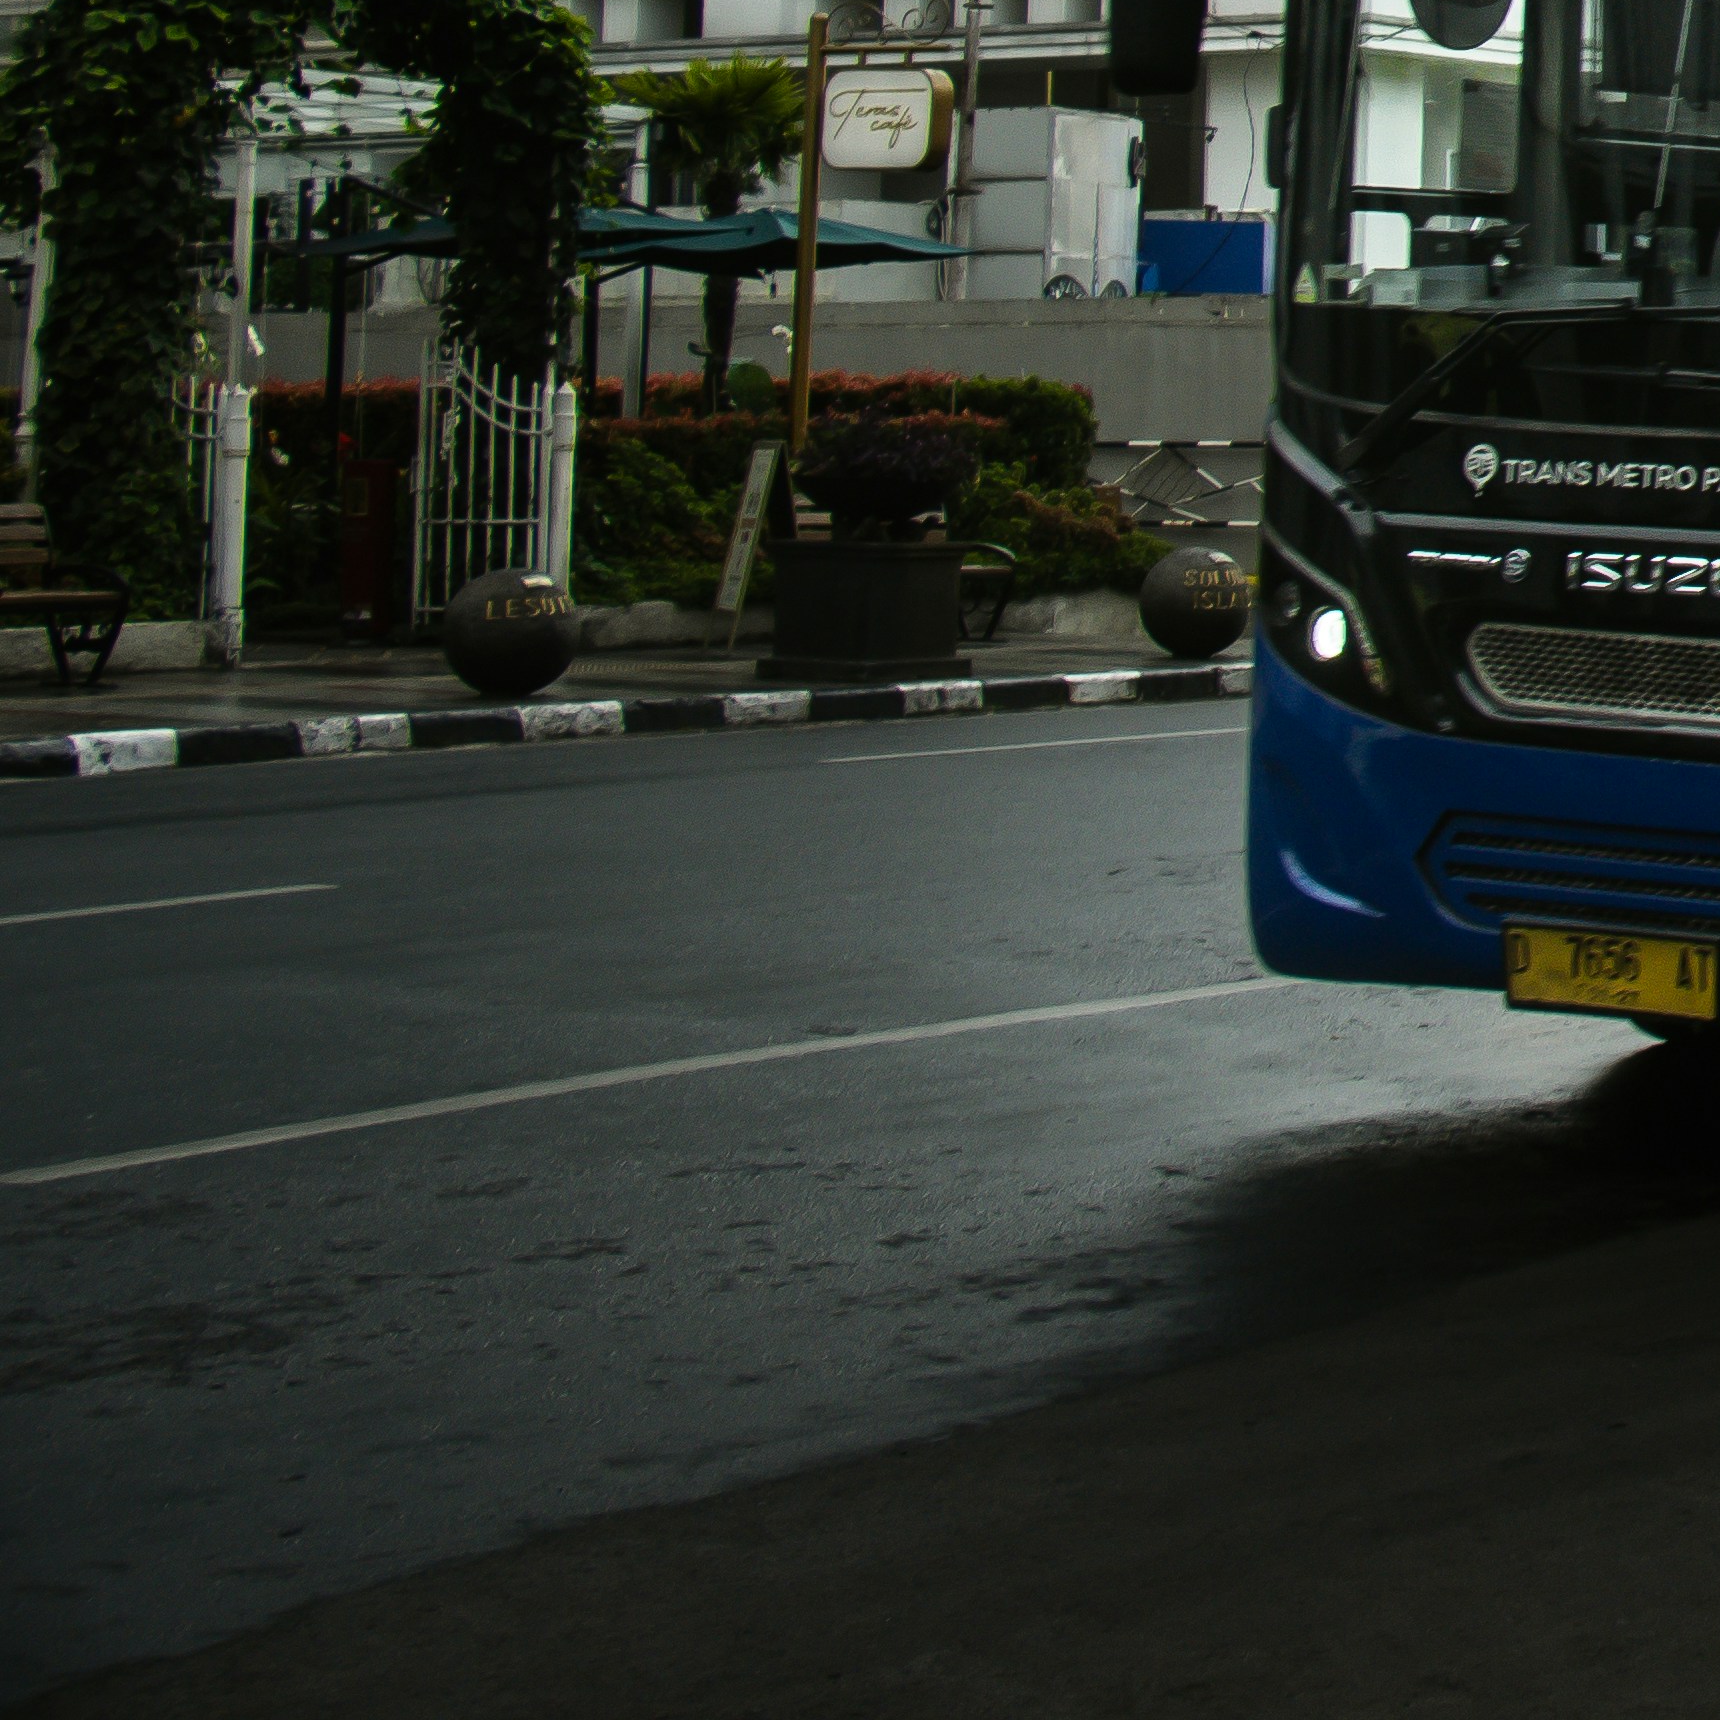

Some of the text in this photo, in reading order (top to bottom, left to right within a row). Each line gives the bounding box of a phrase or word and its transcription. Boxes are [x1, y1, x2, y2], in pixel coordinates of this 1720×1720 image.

[1501, 457, 1593, 487] TRANS
[1595, 461, 1697, 492] METRO
[1676, 943, 1716, 993] AT
